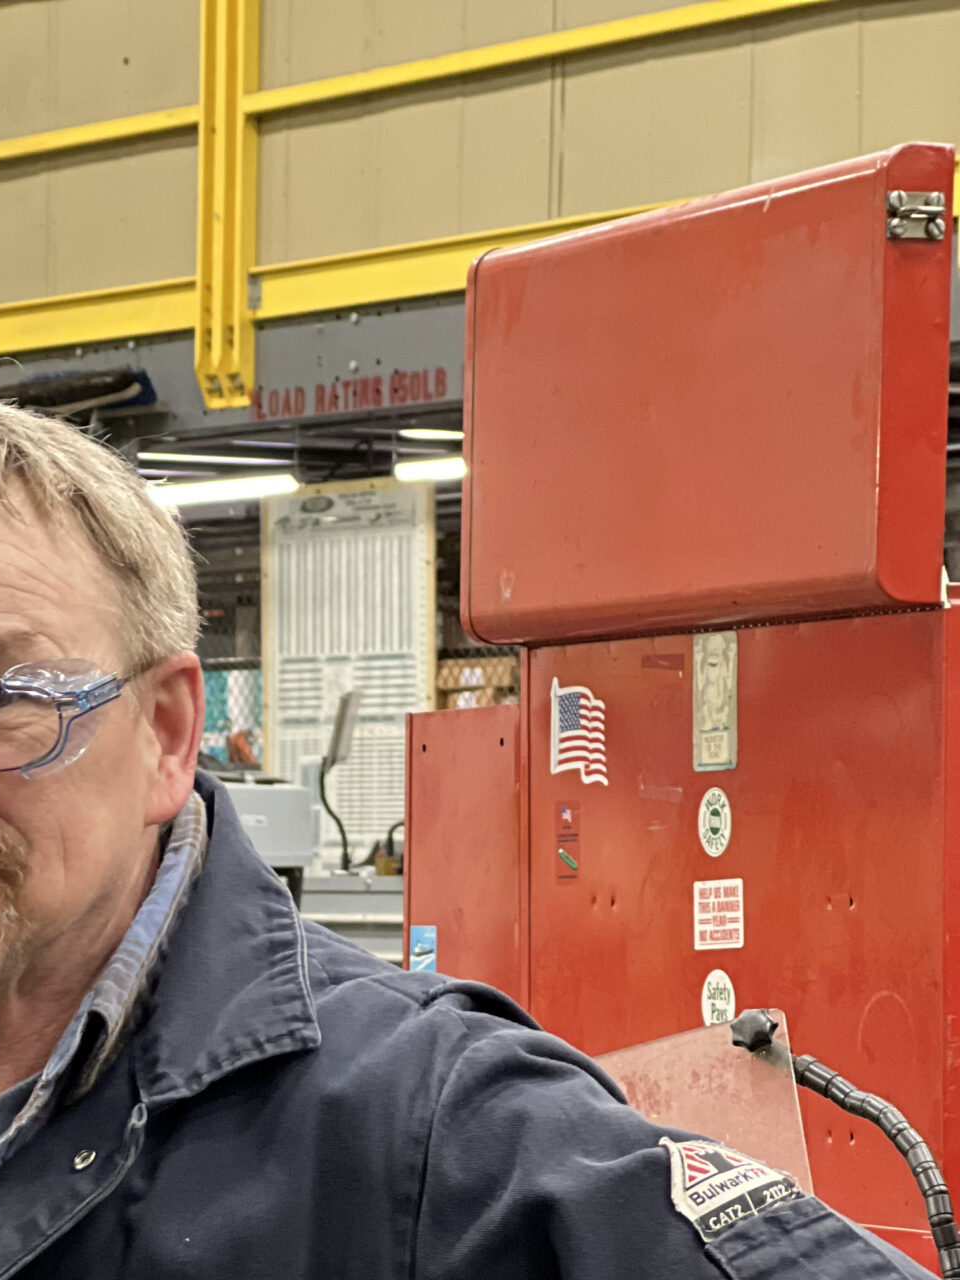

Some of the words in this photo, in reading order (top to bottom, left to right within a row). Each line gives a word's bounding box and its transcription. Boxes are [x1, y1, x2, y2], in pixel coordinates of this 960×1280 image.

[252, 385, 305, 420] LOAD
[315, 376, 383, 413] RATING
[707, 981, 731, 1005] Safety
[711, 1002, 728, 1023] Pays
[688, 1171, 752, 1207] Bulwark
